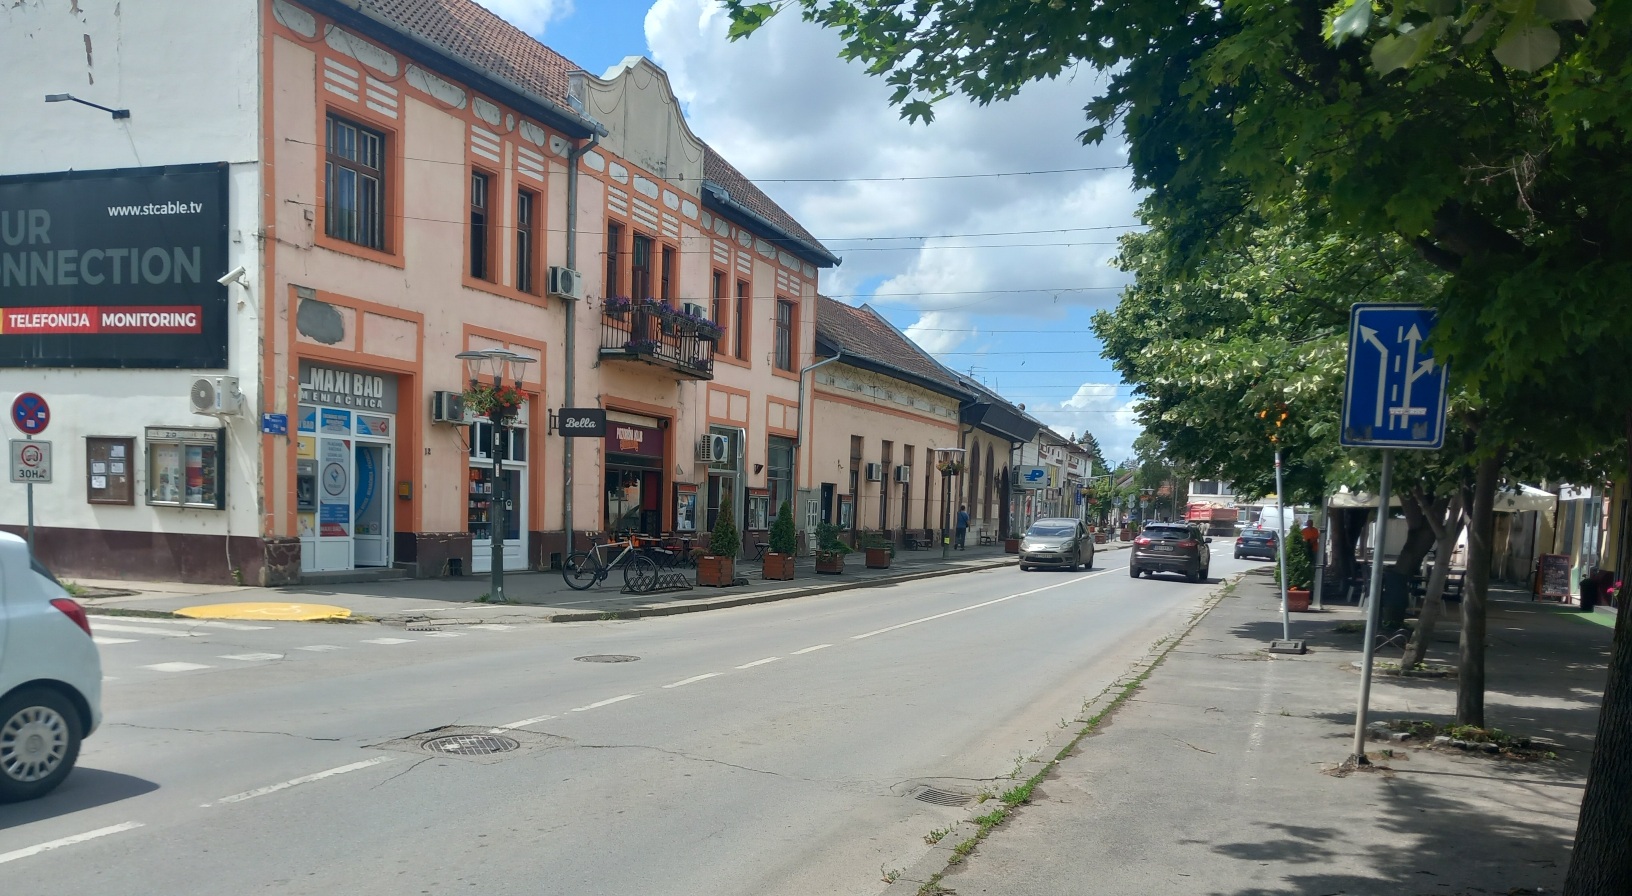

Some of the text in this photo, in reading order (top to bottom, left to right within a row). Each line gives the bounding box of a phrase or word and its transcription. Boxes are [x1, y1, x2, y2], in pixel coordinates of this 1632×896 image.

[107, 200, 203, 217] www.stcable.tv
[1, 208, 51, 246] UR
[0, 246, 202, 287] NNECTION
[9, 313, 90, 328] TELEFONIJA
[102, 312, 197, 327] MONITORING
[309, 367, 383, 398] MAXI BAD
[565, 417, 597, 428] Bella
